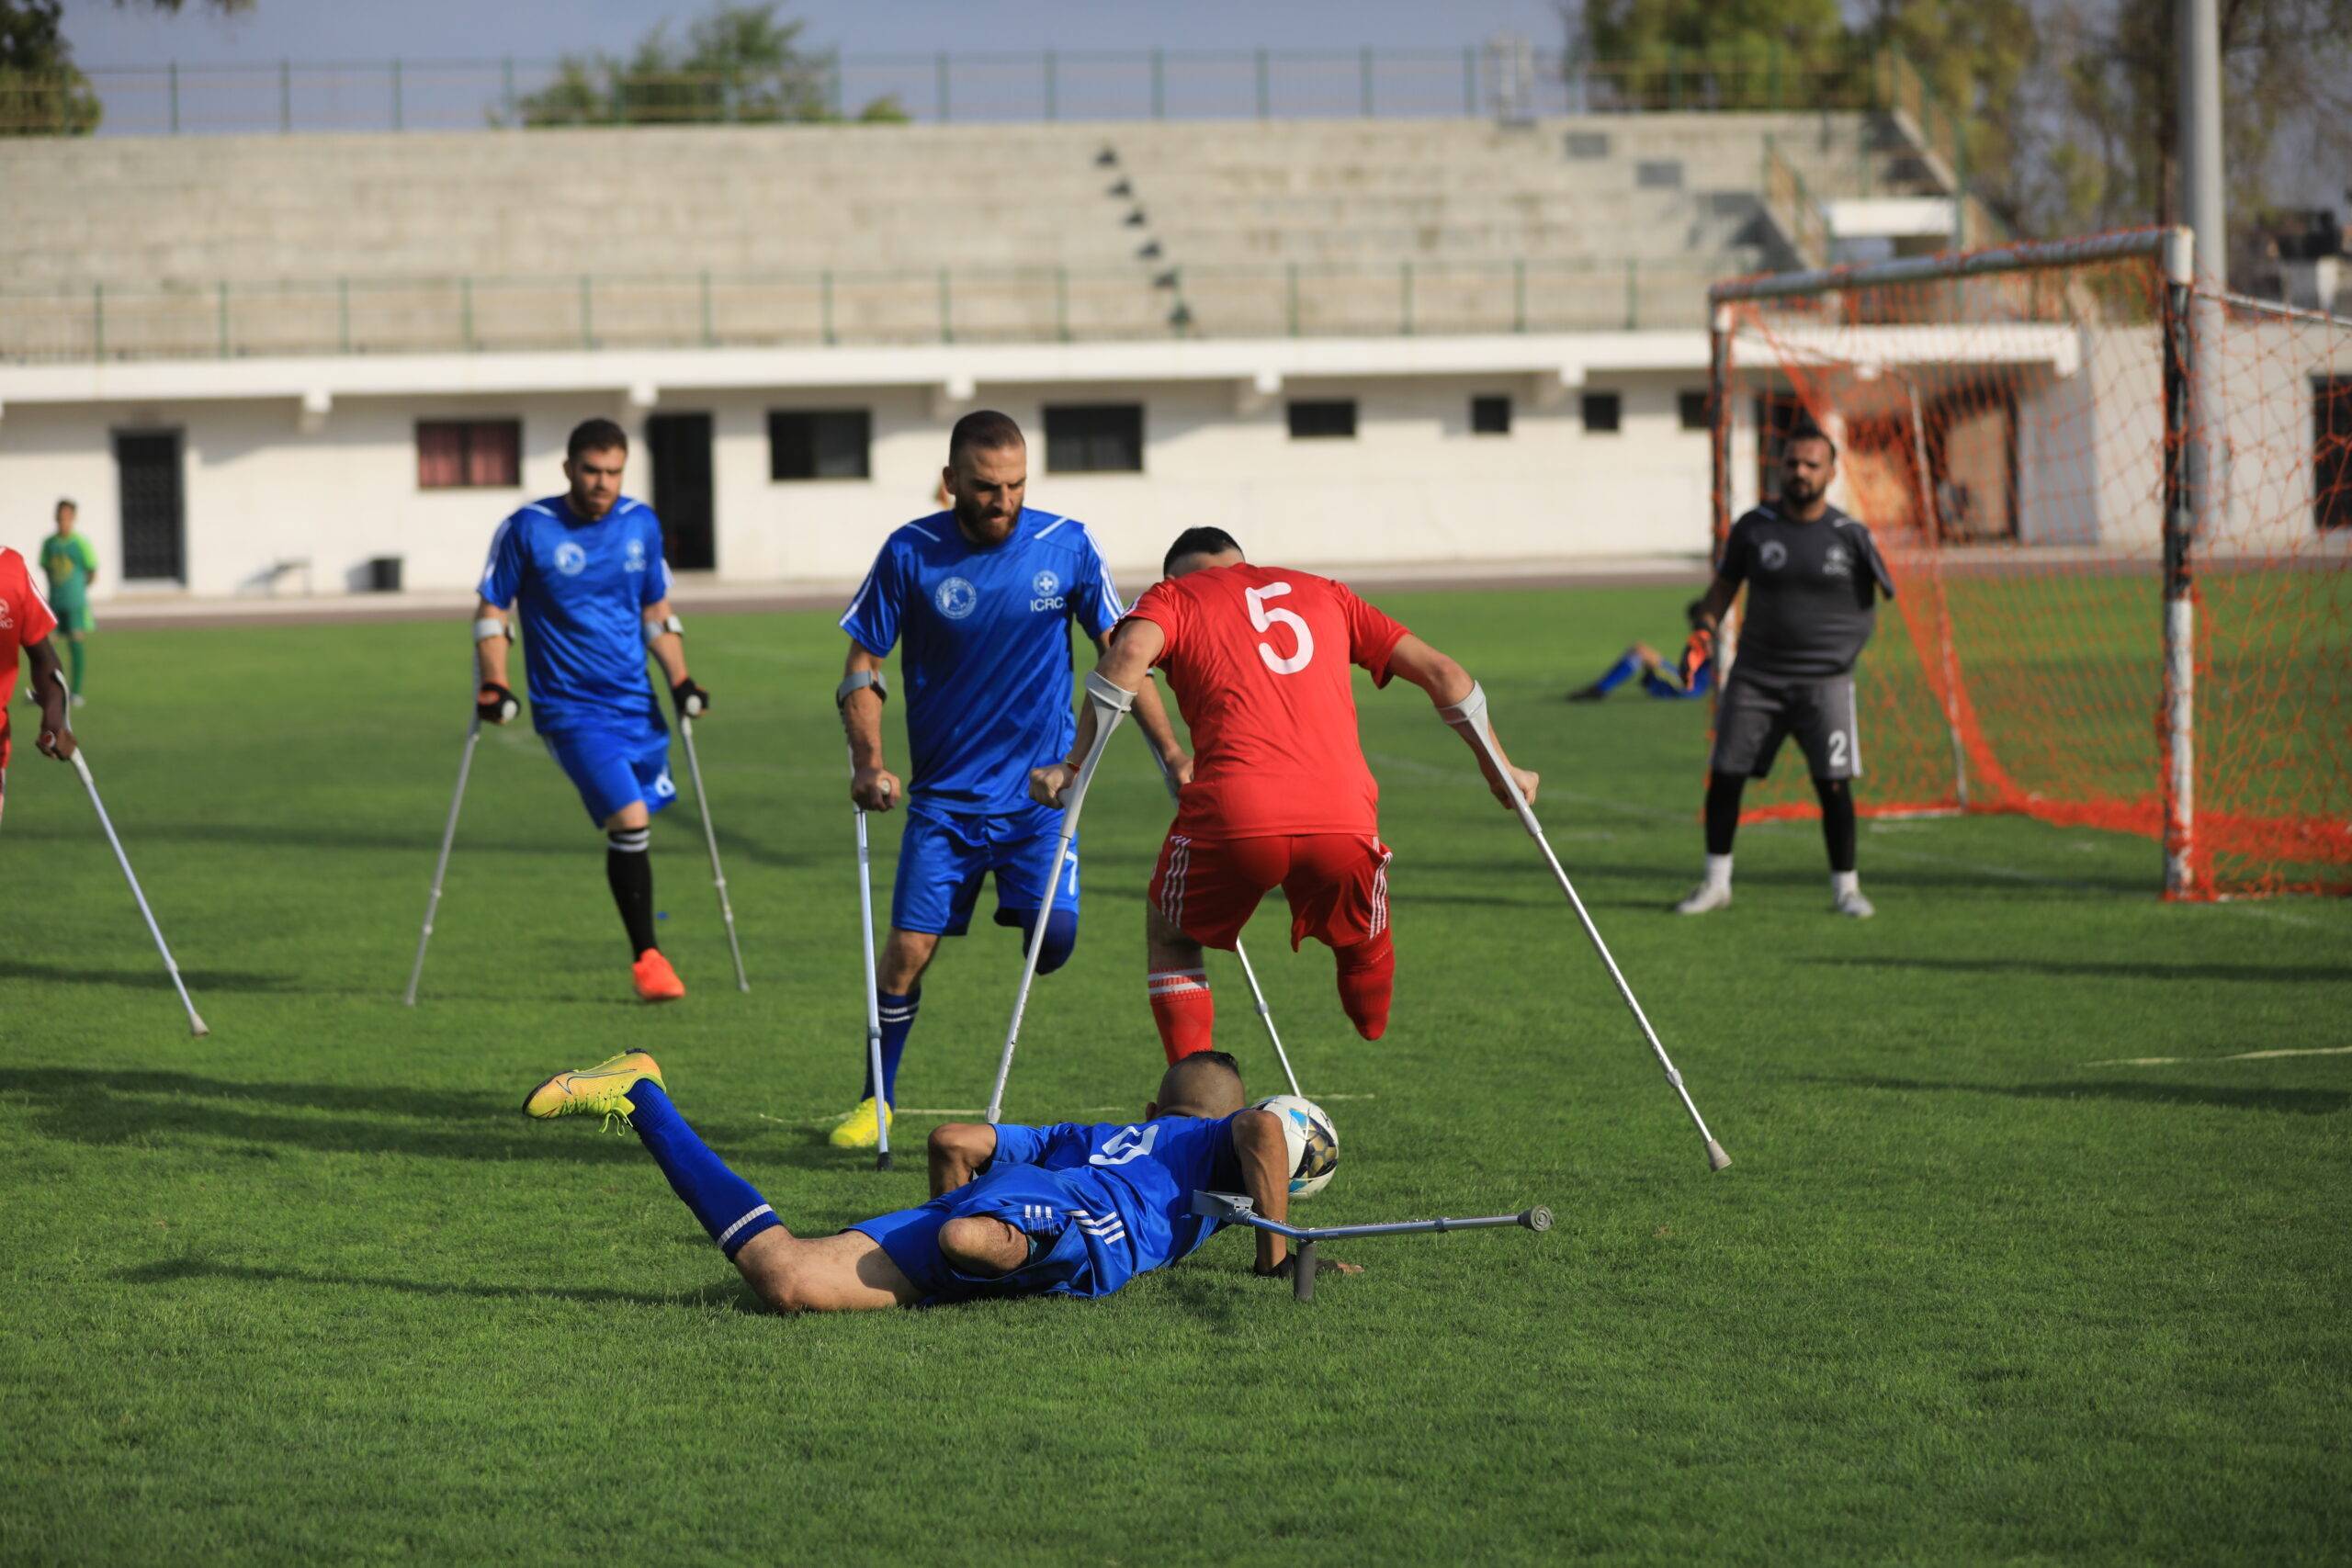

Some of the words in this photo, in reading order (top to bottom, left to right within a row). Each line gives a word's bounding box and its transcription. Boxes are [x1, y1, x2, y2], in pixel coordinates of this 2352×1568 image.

[1030, 596, 1064, 613] ICRC
[1245, 581, 1314, 674] 5
[1828, 730, 1848, 767] 2
